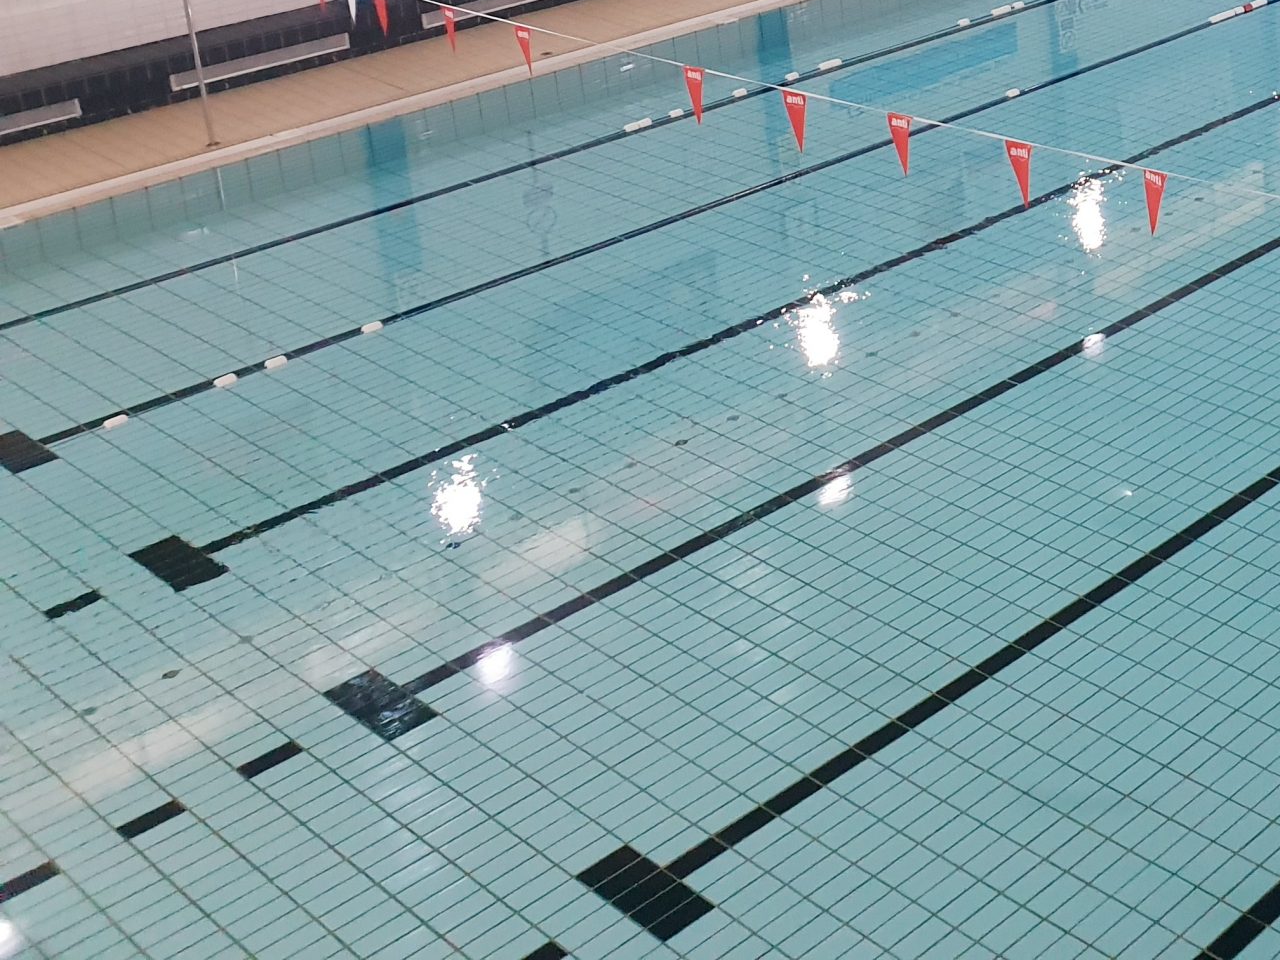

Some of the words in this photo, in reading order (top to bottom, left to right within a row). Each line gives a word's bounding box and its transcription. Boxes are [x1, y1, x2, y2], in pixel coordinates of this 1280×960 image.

[687, 69, 701, 80] anti
[786, 95, 804, 105] anti
[891, 117, 908, 128] anti
[1010, 145, 1029, 159] anti
[1144, 170, 1162, 187] anti
